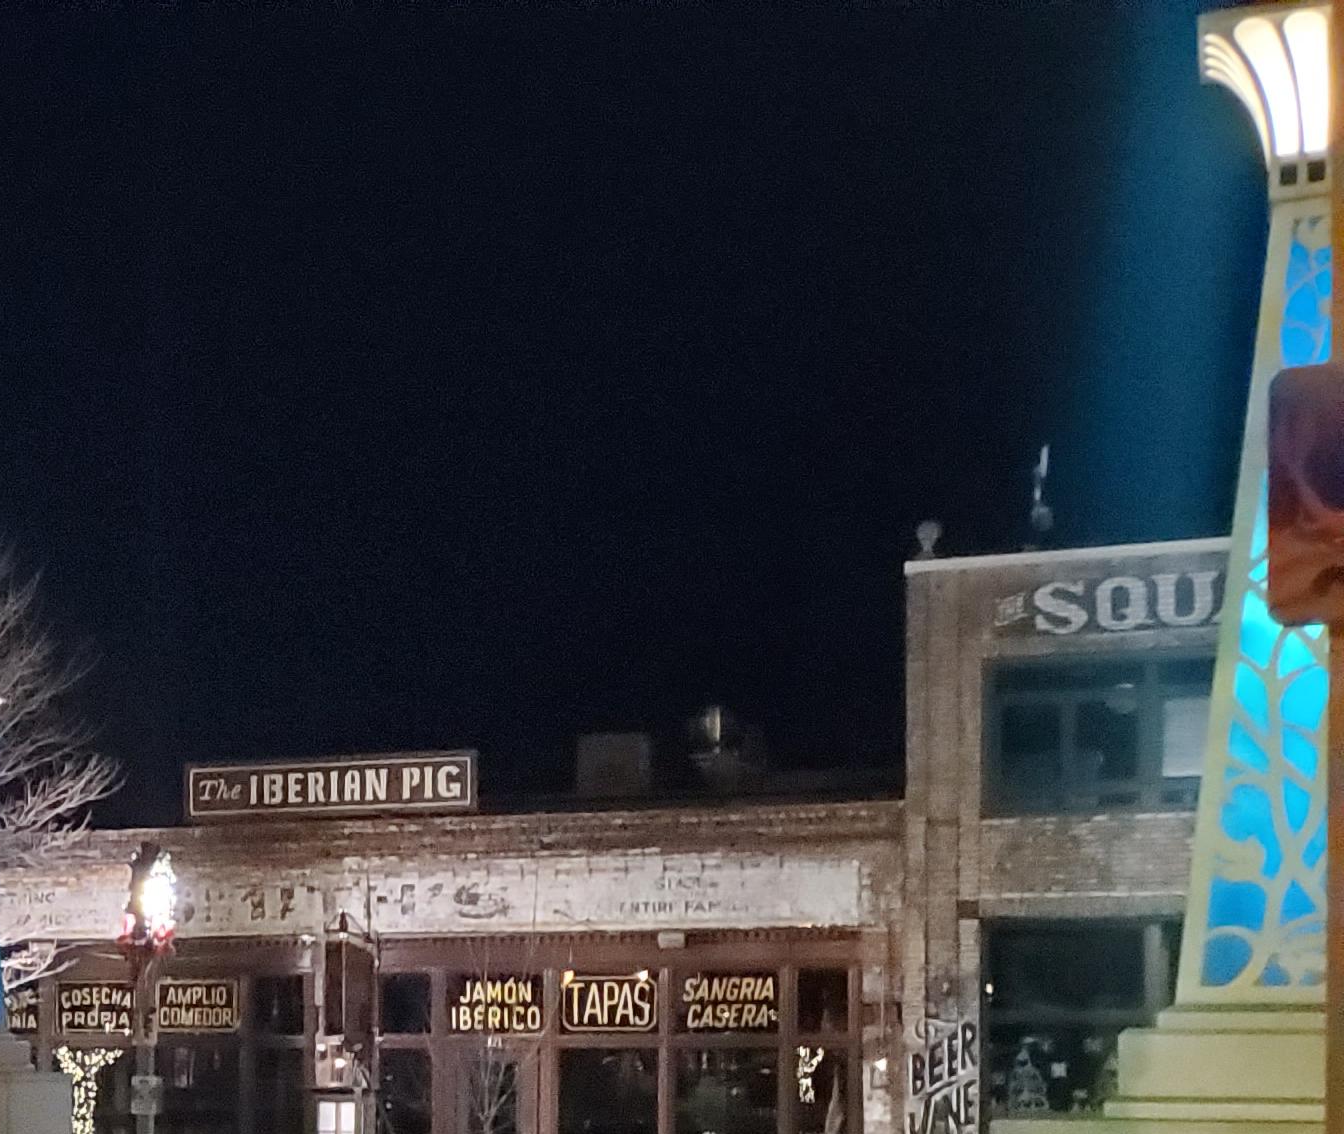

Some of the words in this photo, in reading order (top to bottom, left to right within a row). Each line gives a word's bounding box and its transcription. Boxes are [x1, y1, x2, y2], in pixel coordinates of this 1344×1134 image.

[1033, 571, 1222, 635] SQU
[198, 778, 242, 801] The
[249, 767, 389, 806] IBERIAN
[401, 764, 461, 800] PIG
[61, 987, 132, 1009] COSECHA
[166, 986, 227, 1006] AMPLIO
[459, 977, 532, 1003] JAMÓN
[160, 1007, 233, 1026] COMEDOR
[569, 982, 651, 1026] TAPAS
[686, 1004, 769, 1028] CASERA
[62, 1011, 131, 1027] PROPIA
[912, 1022, 977, 1096] BEER
